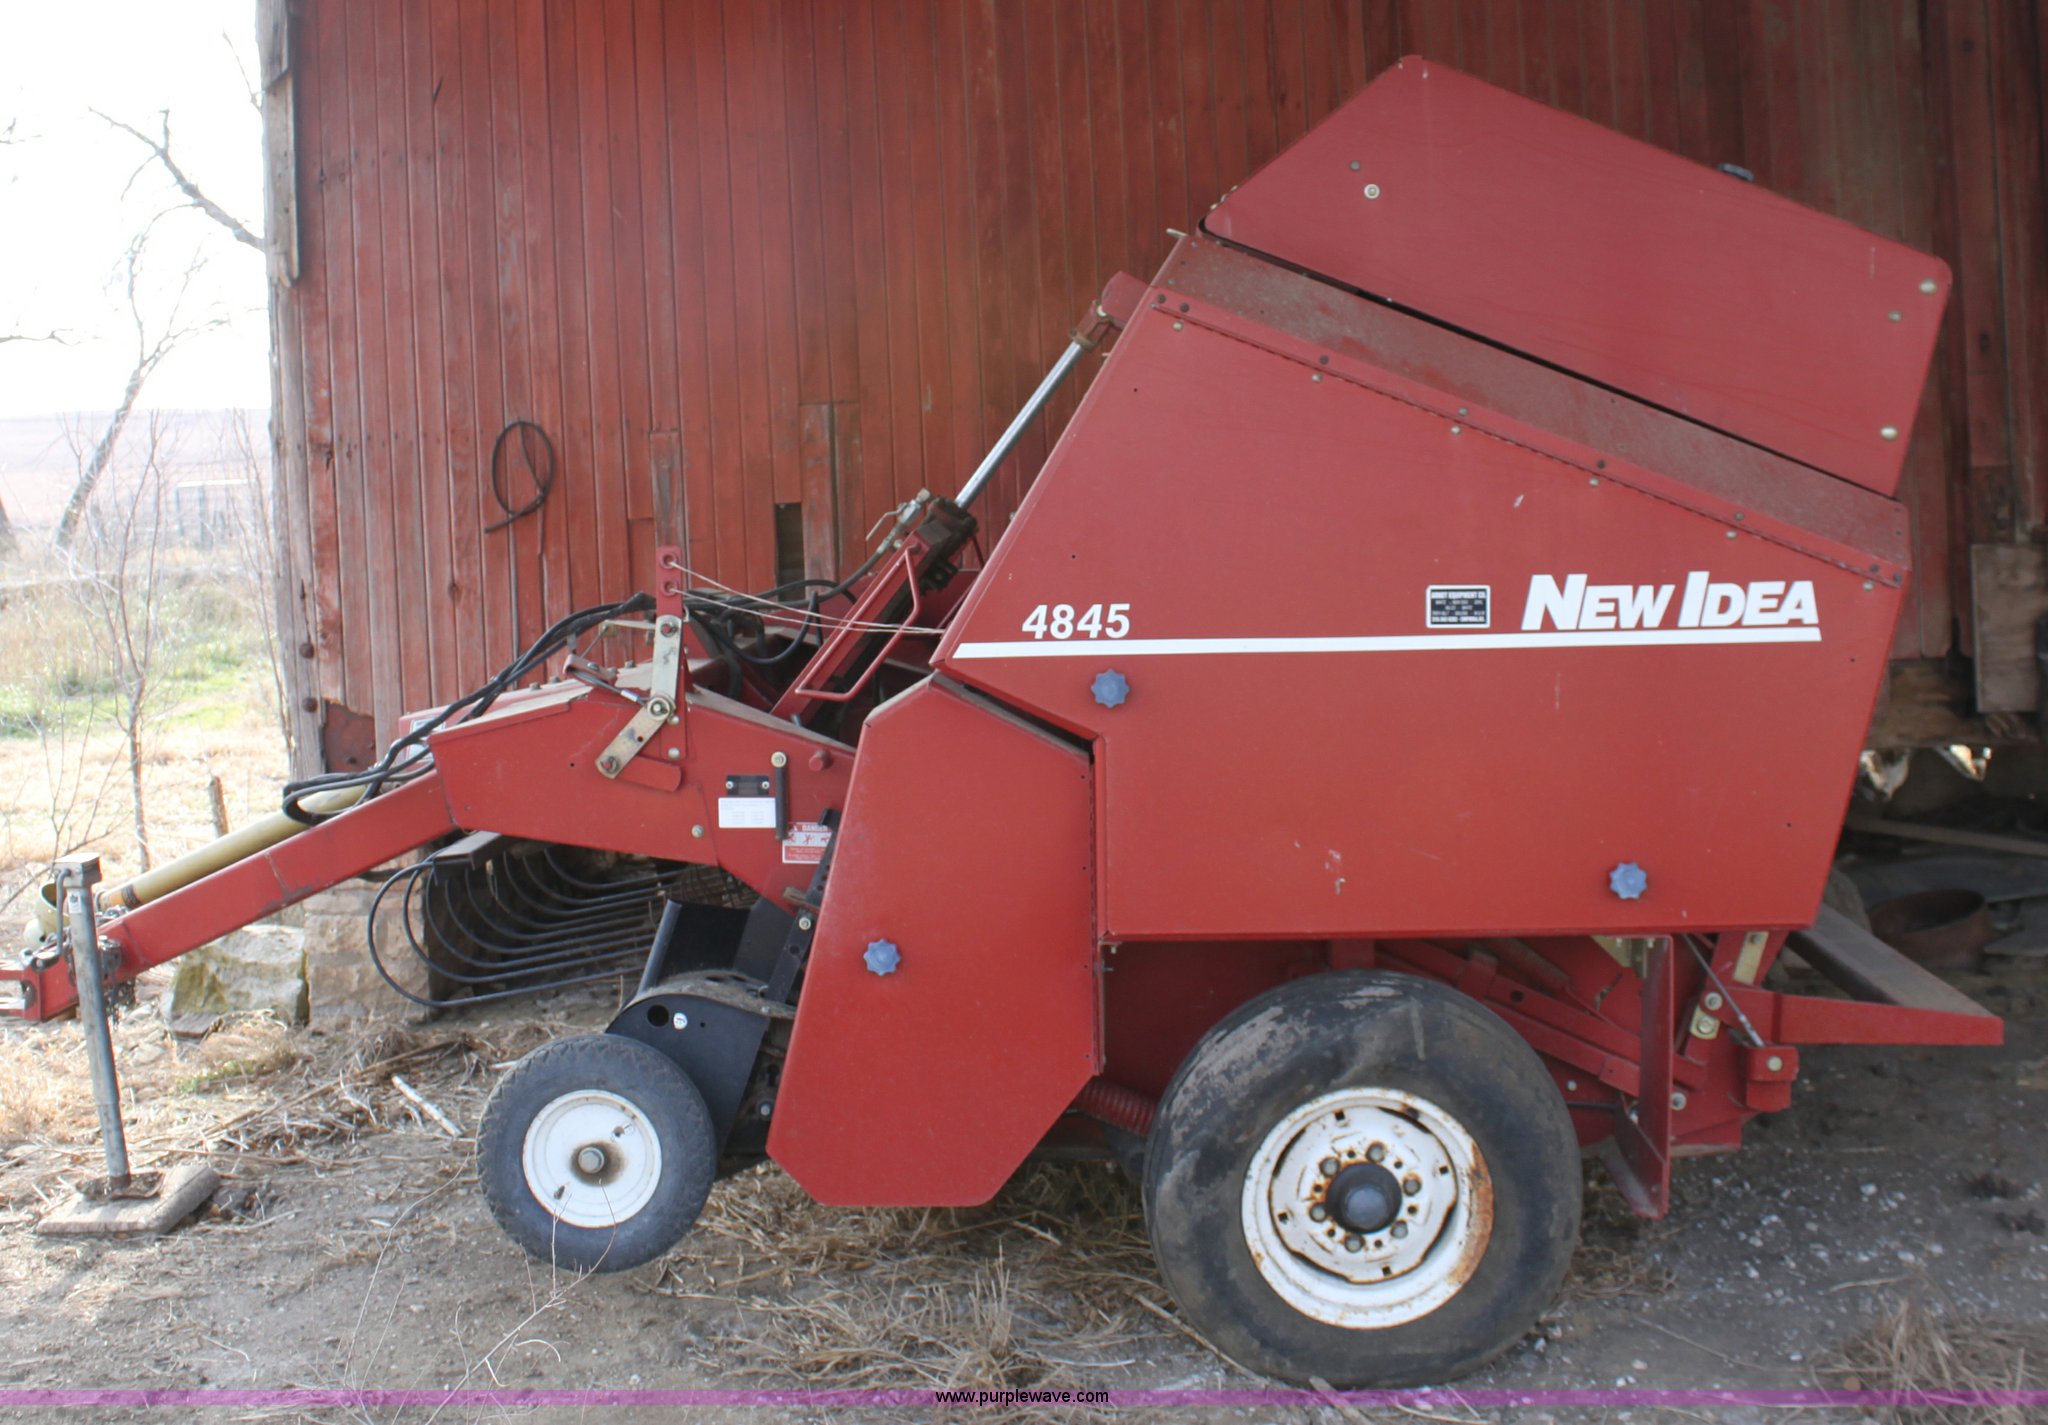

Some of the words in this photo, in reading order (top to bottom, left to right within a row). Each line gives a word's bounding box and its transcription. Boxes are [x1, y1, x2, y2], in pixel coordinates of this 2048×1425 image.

[1021, 603, 1131, 639] 4845
[1521, 573, 1676, 630] NEW
[1677, 571, 1819, 627] IDEA
